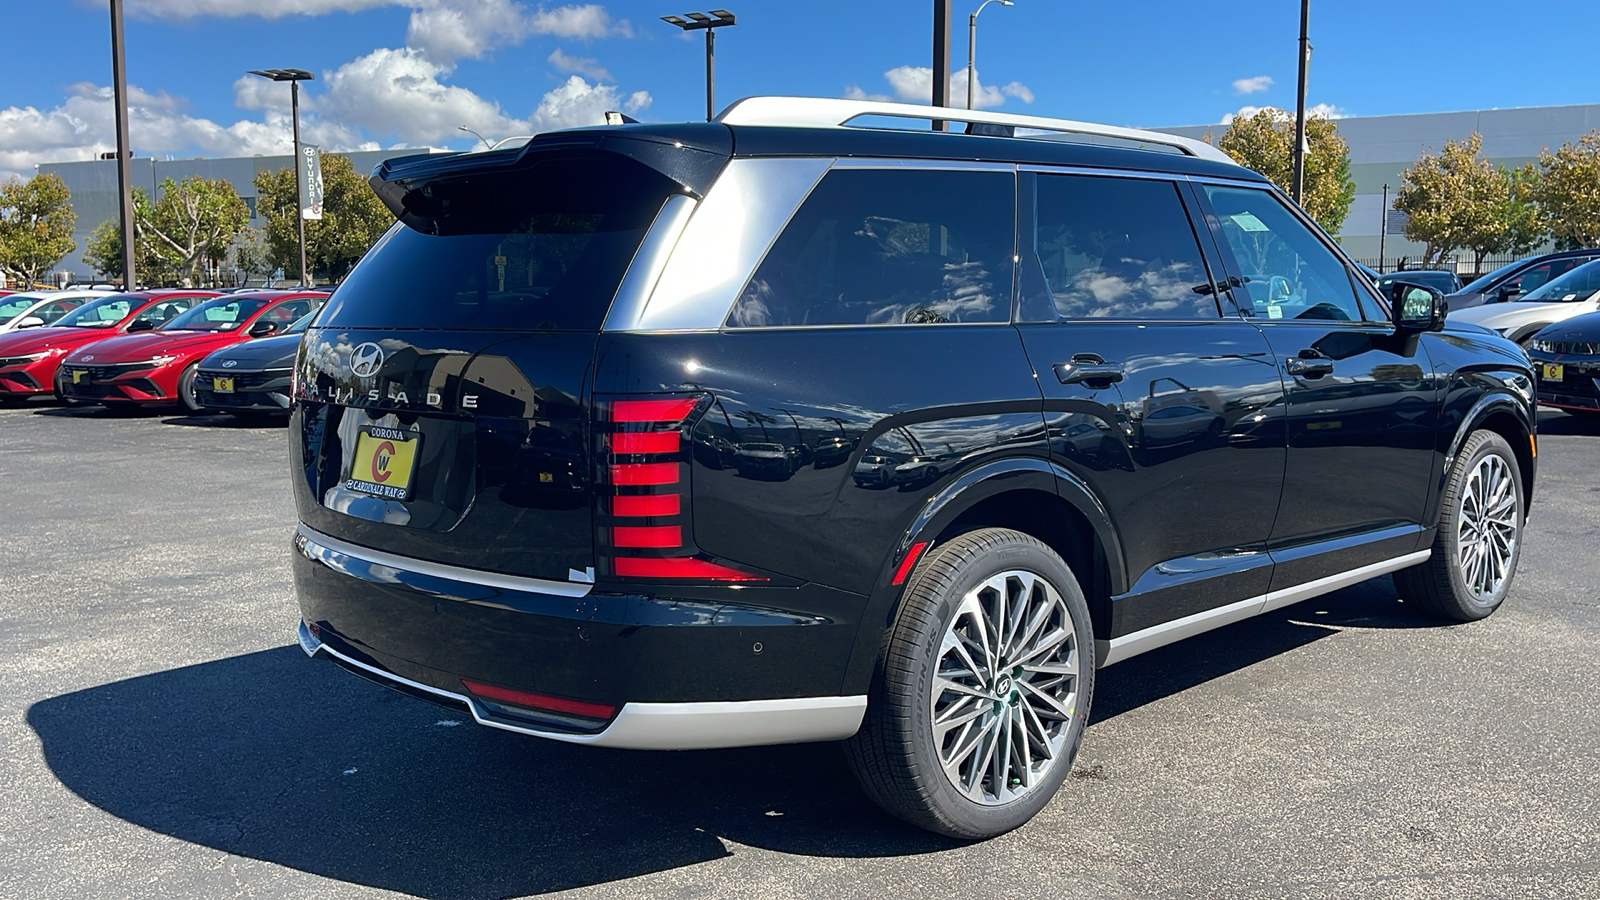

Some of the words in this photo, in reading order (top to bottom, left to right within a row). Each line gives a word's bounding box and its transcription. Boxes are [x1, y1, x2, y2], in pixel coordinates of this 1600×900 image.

[307, 157, 315, 205] HYUNDAI
[371, 427, 403, 440] CORONA
[353, 480, 384, 496] CARDINALE
[384, 485, 399, 498] WAY
[916, 661, 929, 762] CORPION
